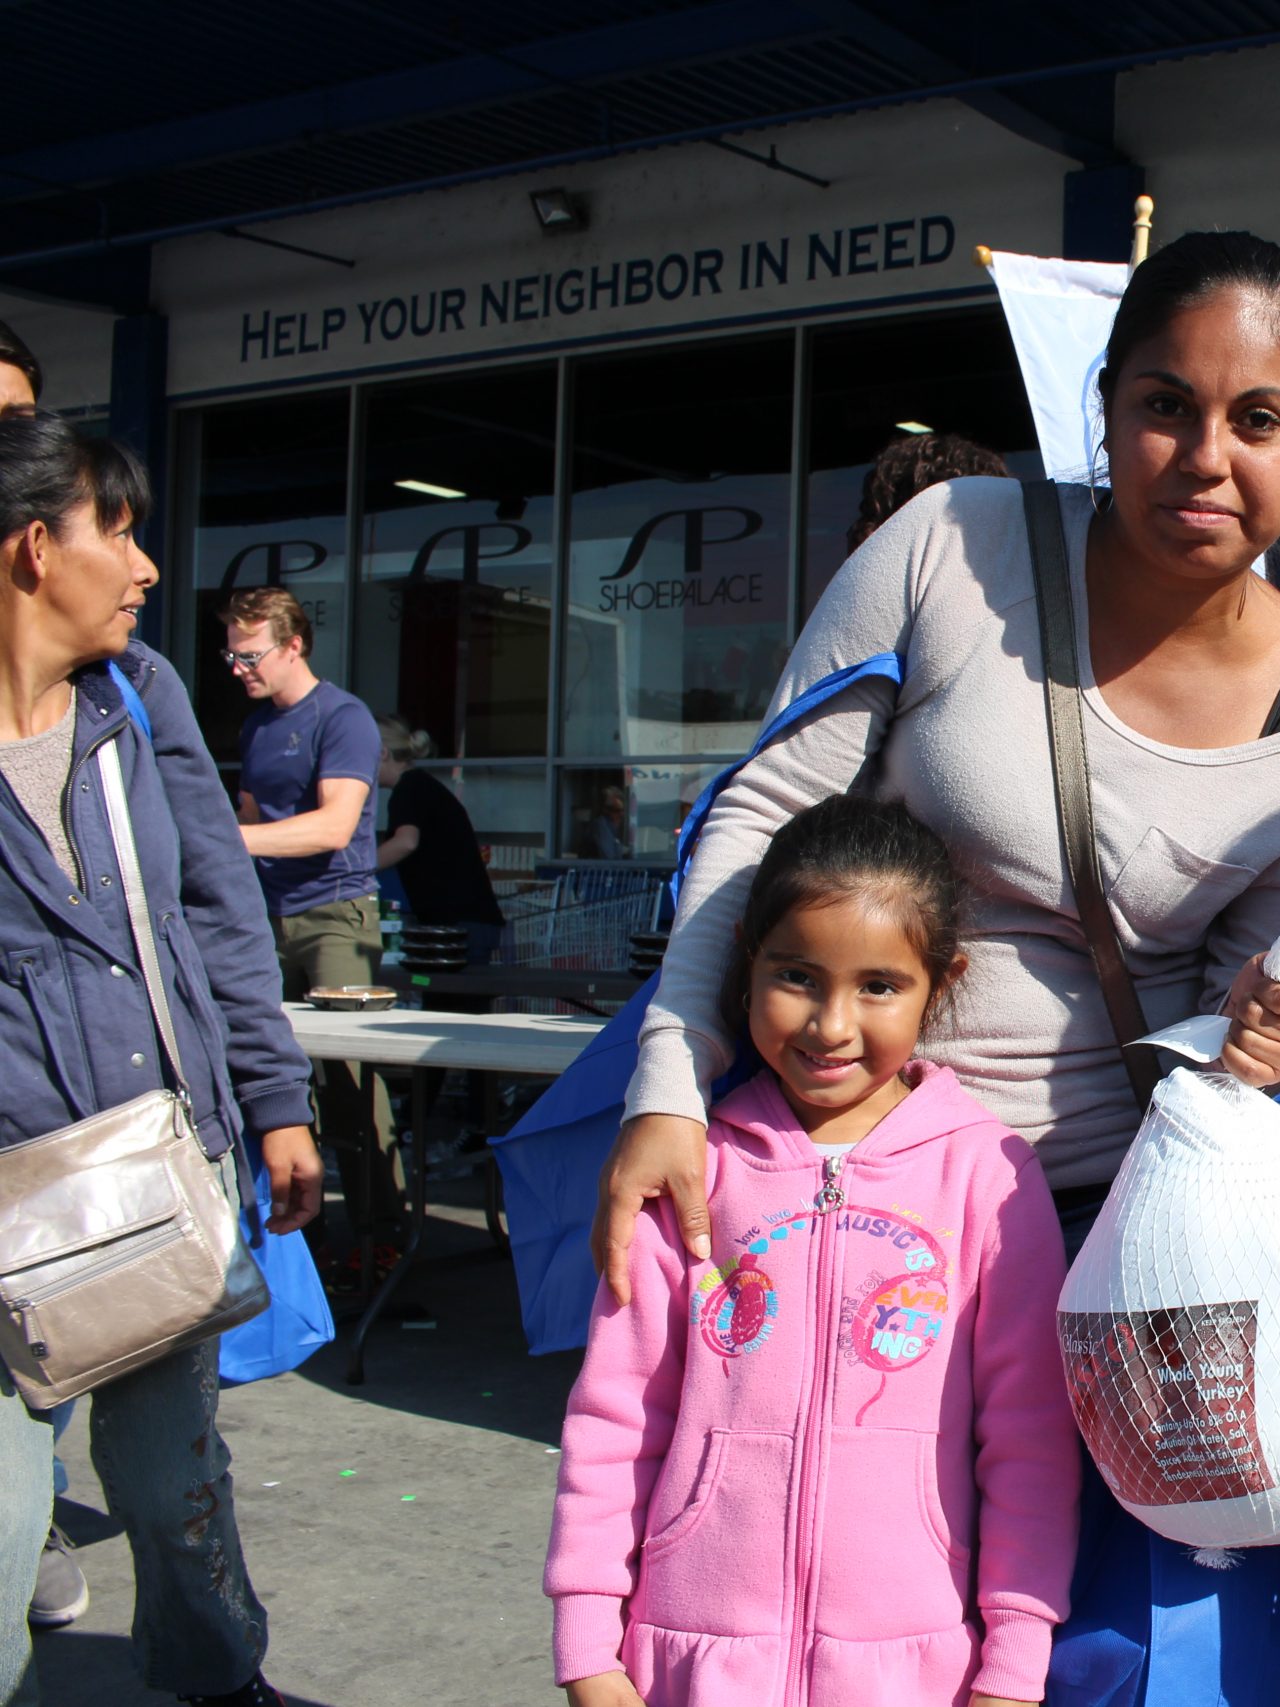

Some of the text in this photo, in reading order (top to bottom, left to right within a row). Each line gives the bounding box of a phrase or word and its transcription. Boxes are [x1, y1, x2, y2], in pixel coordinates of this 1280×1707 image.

[239, 214, 956, 363] HELP YOUR NEIGHBOR IN NEED
[1157, 1363, 1243, 1384] Whole Young
[1196, 1382, 1244, 1401] Turkey
